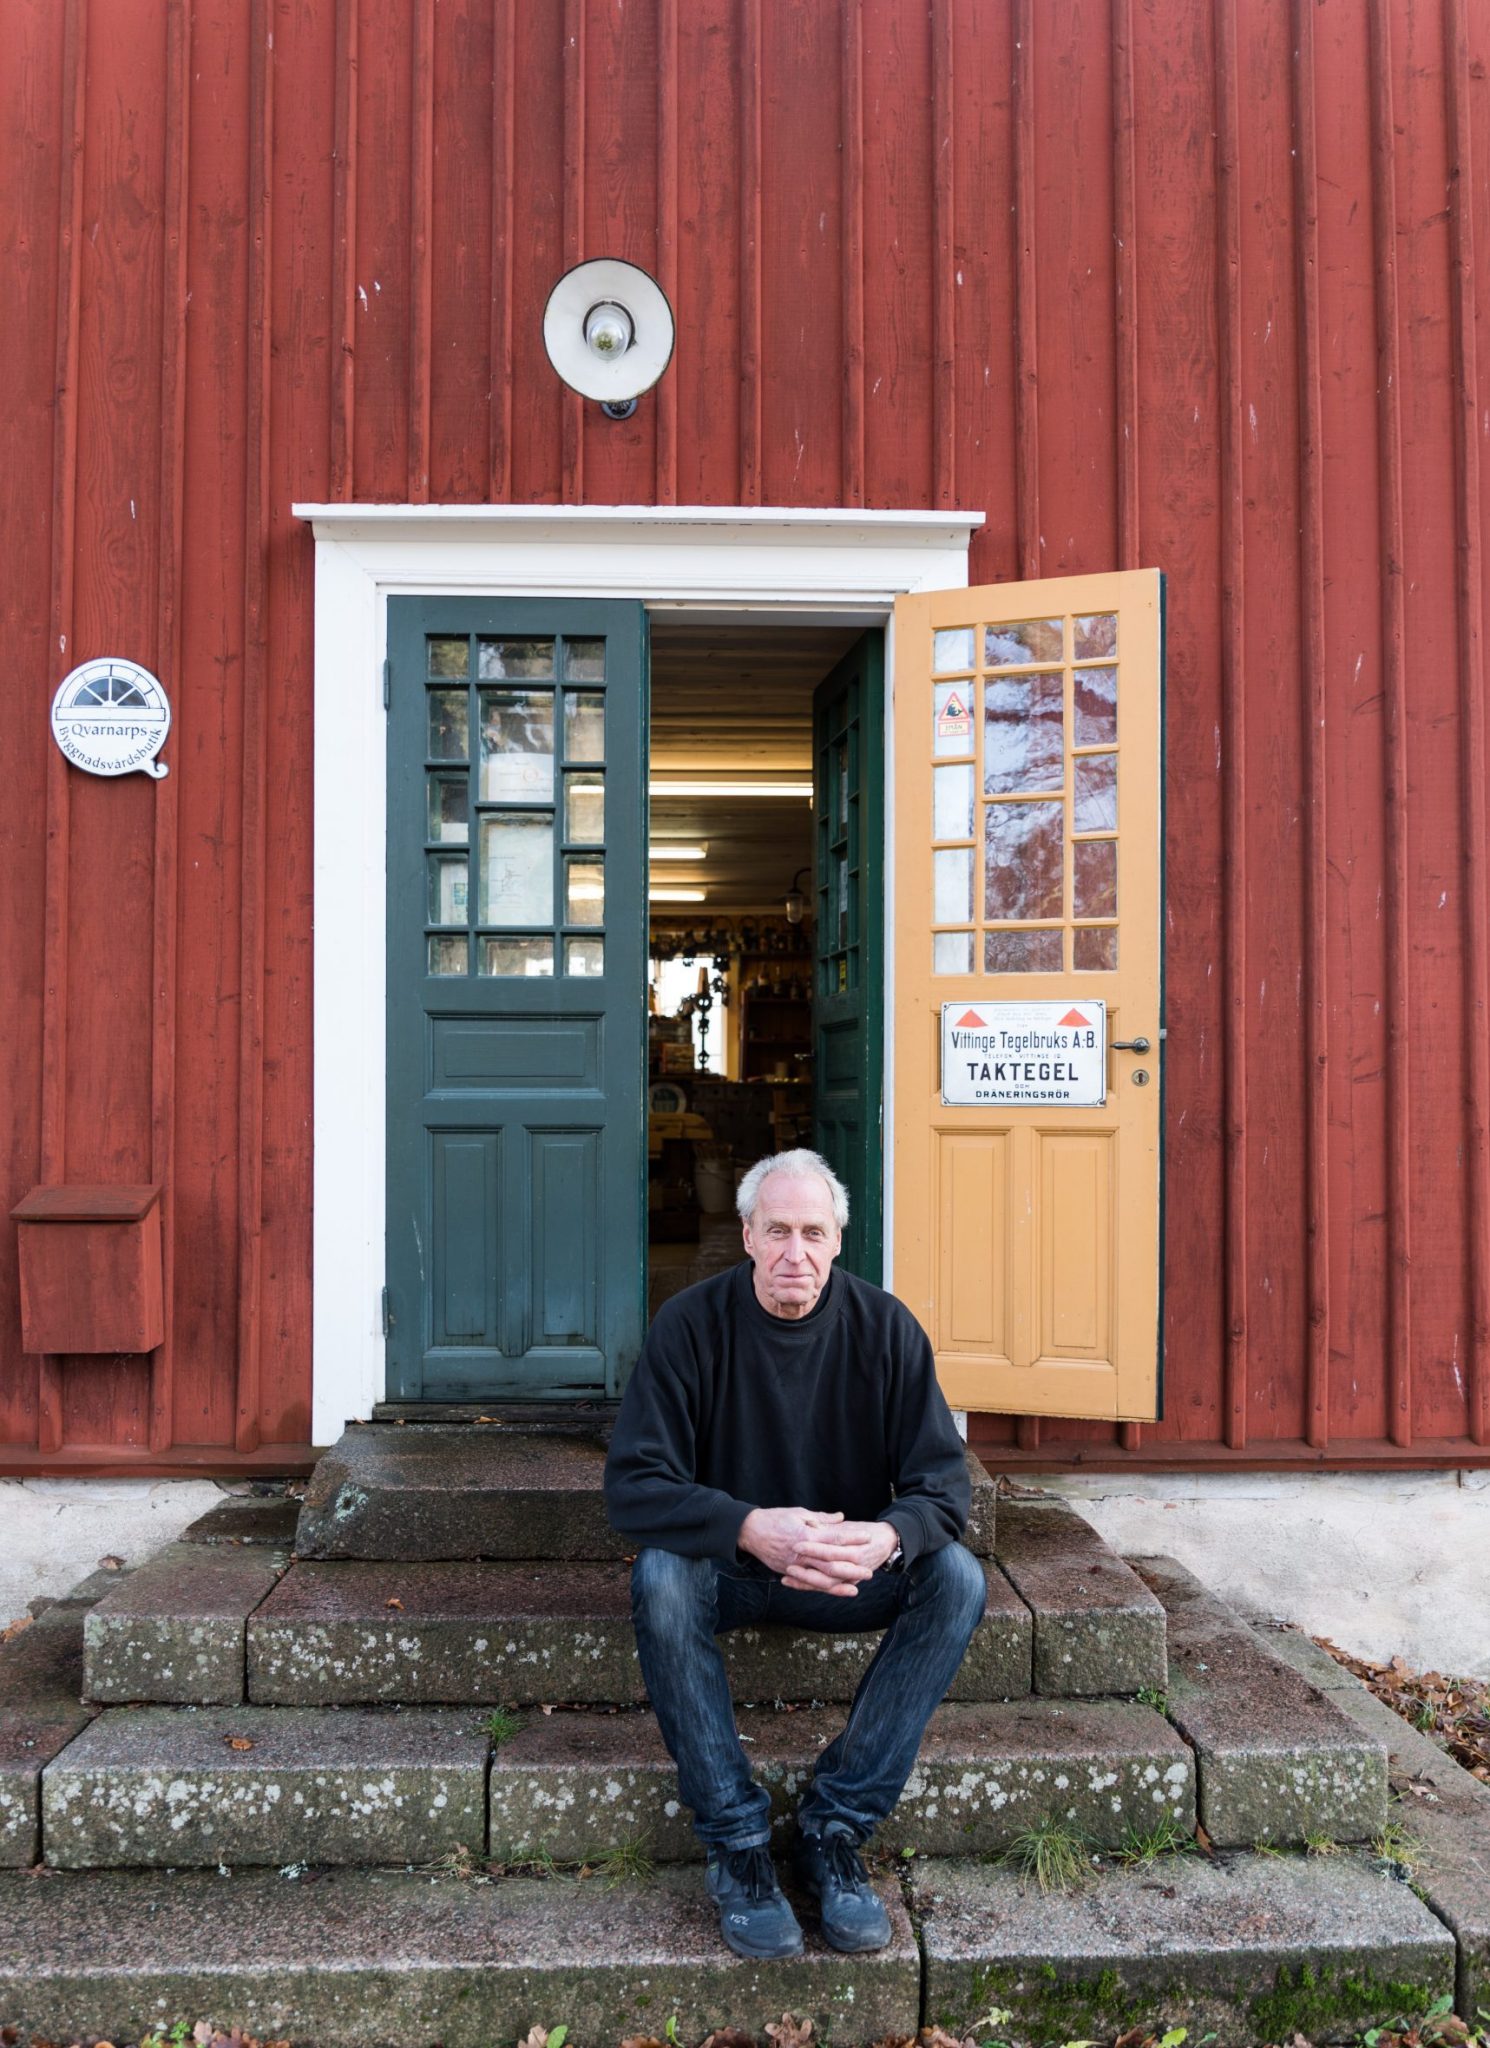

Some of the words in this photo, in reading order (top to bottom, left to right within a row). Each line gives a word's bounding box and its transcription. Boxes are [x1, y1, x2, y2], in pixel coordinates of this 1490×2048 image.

[71, 724, 147, 739] Qvarnarps
[951, 1031, 996, 1052] Vittinge
[1000, 1031, 1068, 1052] Tegelbruks
[967, 1063, 1079, 1081] TAKTEGEL
[975, 1088, 1070, 1099] DRÄNERINGSRÖR
